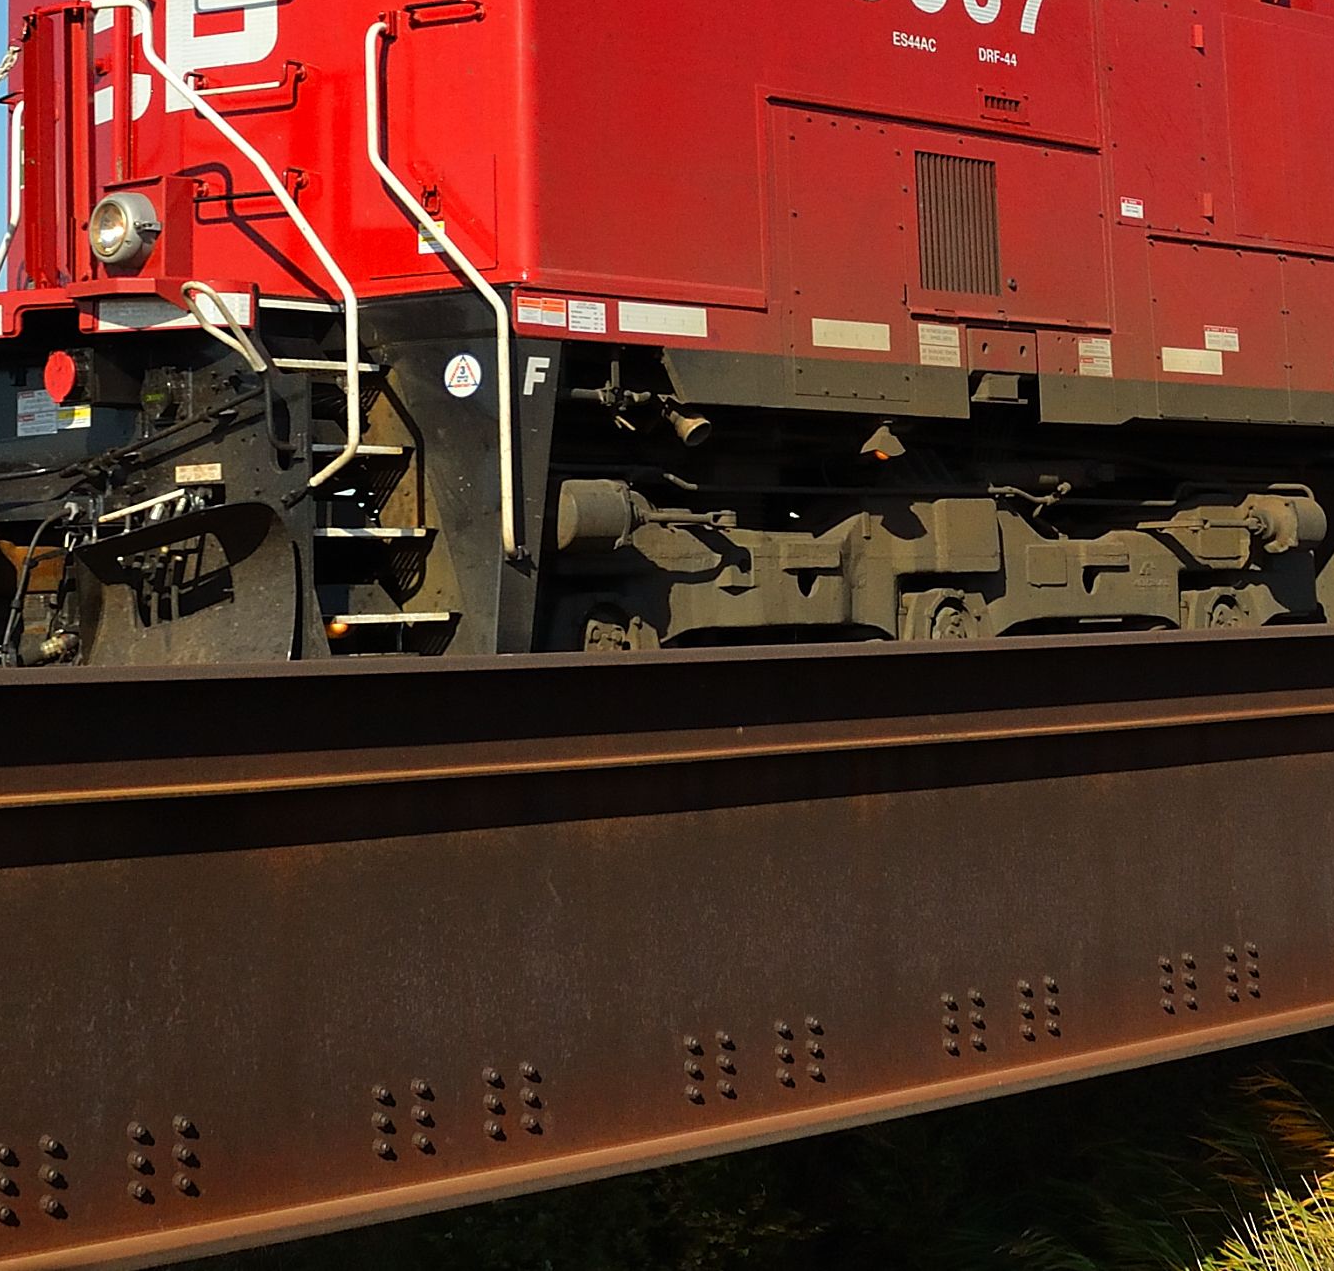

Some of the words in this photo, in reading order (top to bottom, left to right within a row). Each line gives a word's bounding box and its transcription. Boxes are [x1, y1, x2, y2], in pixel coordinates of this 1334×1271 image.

[892, 30, 937, 53] ES44AC
[978, 47, 1017, 67] DRF-44
[523, 356, 550, 395] F
